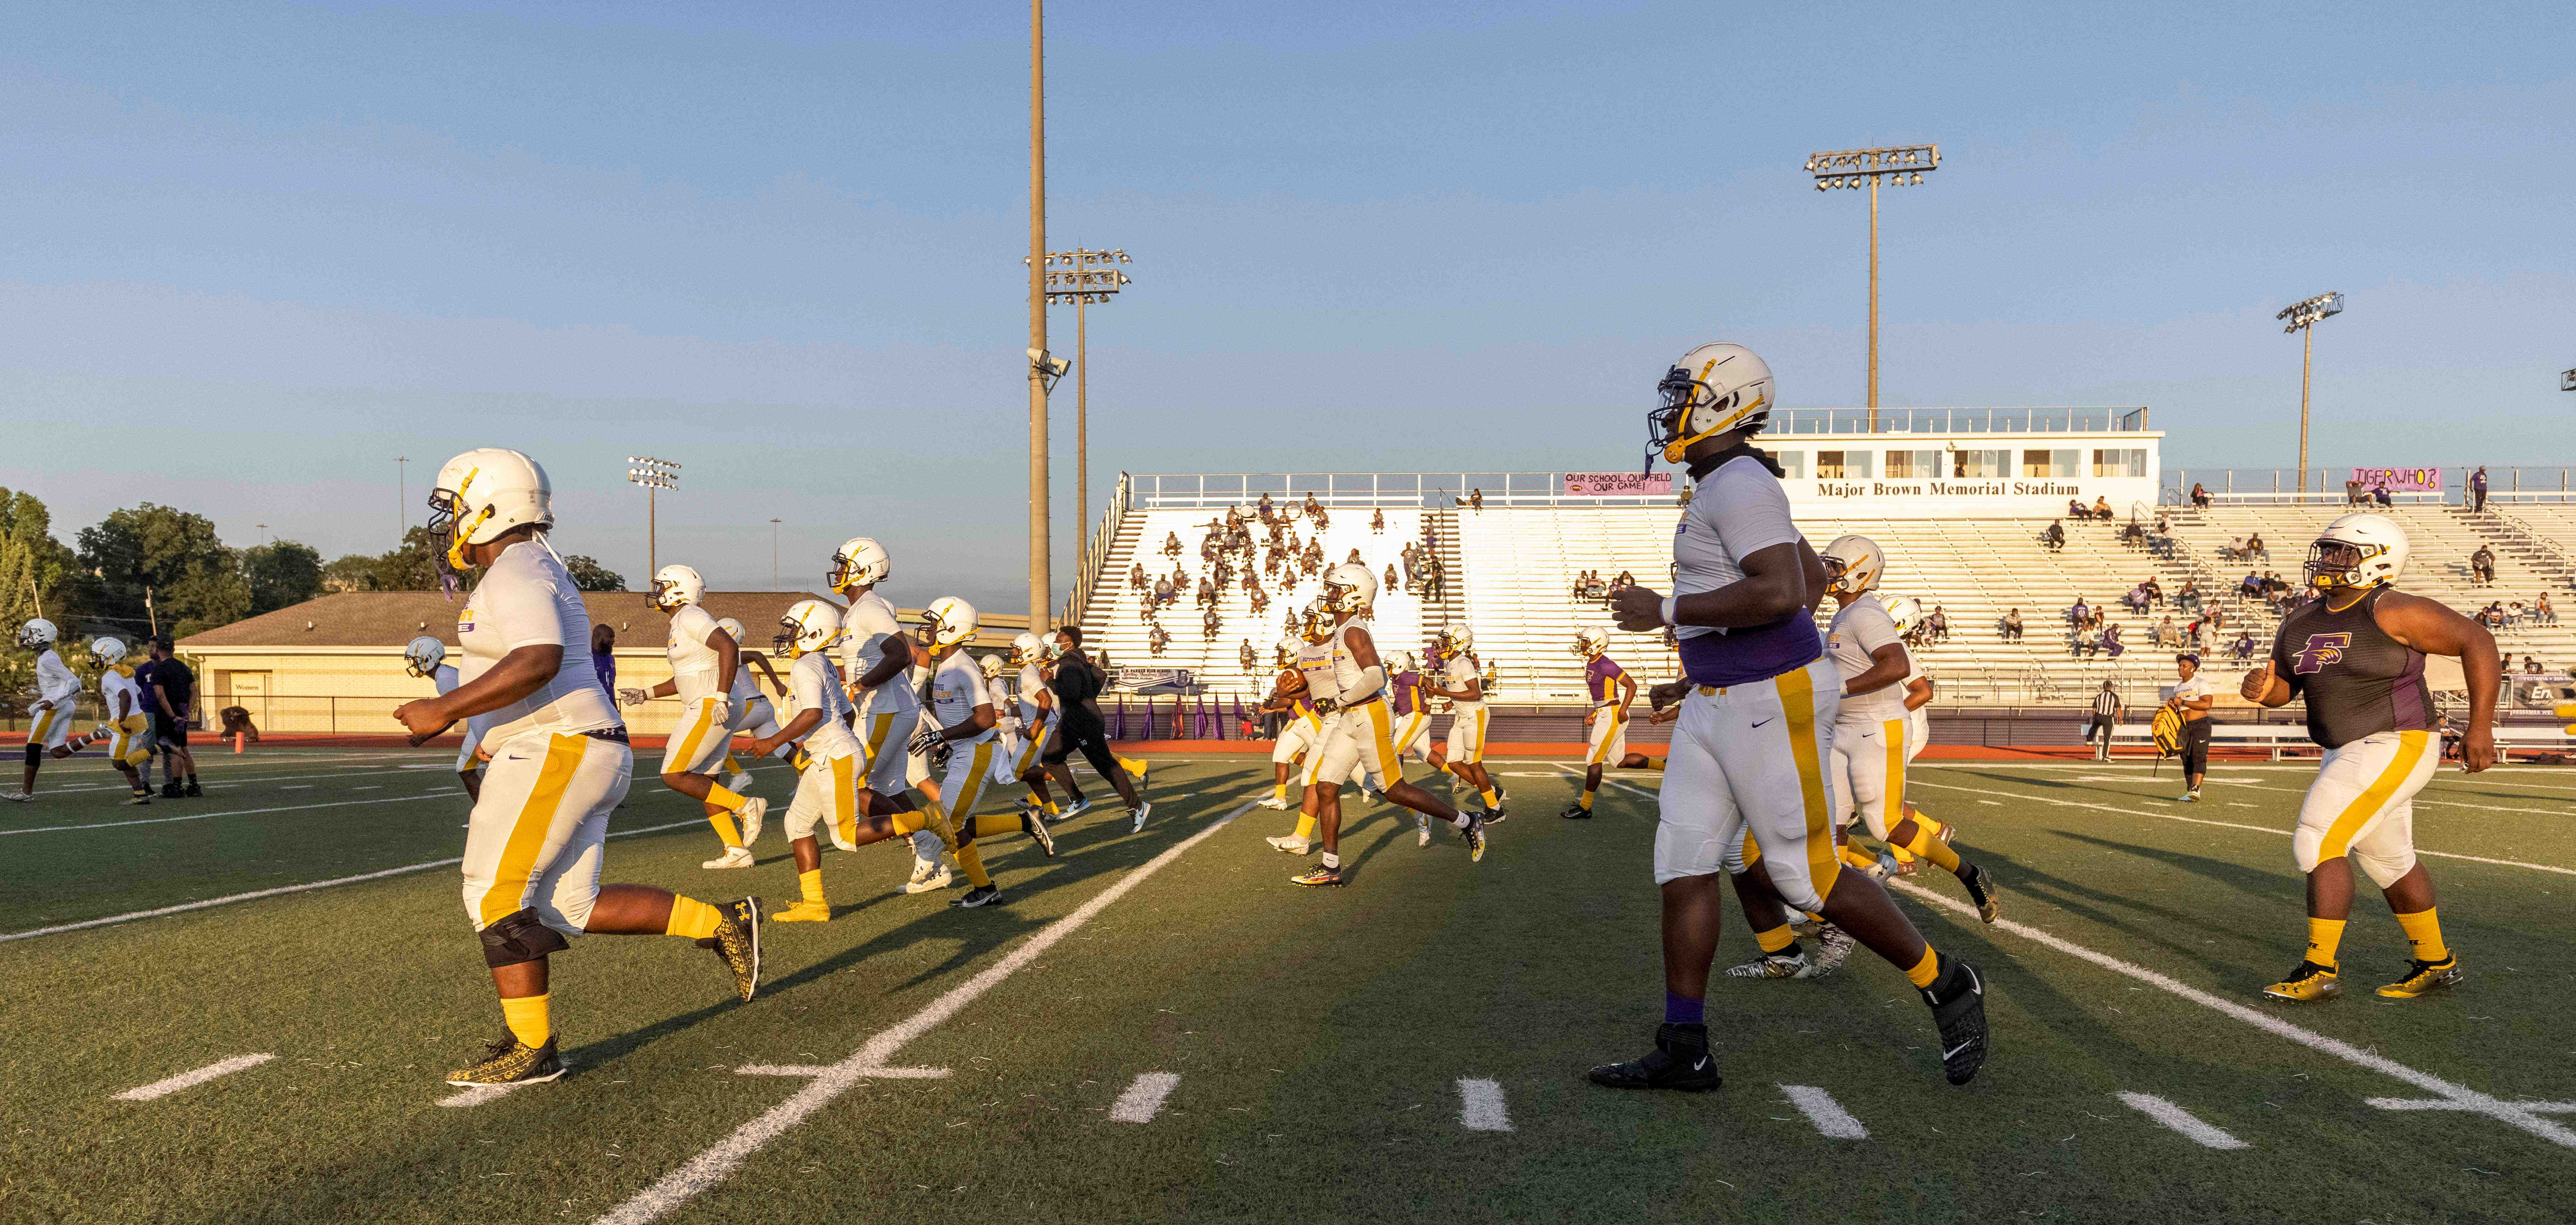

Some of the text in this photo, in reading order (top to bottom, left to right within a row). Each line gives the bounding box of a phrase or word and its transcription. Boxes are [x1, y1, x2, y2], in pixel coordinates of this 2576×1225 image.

[1566, 474, 1585, 482] OUR
[1627, 474, 1648, 482] OUR
[1649, 473, 1671, 482] FIELD
[1594, 482, 1645, 491] OUR GAME!
[1817, 482, 2079, 498] Major Brown Memorial Stadium
